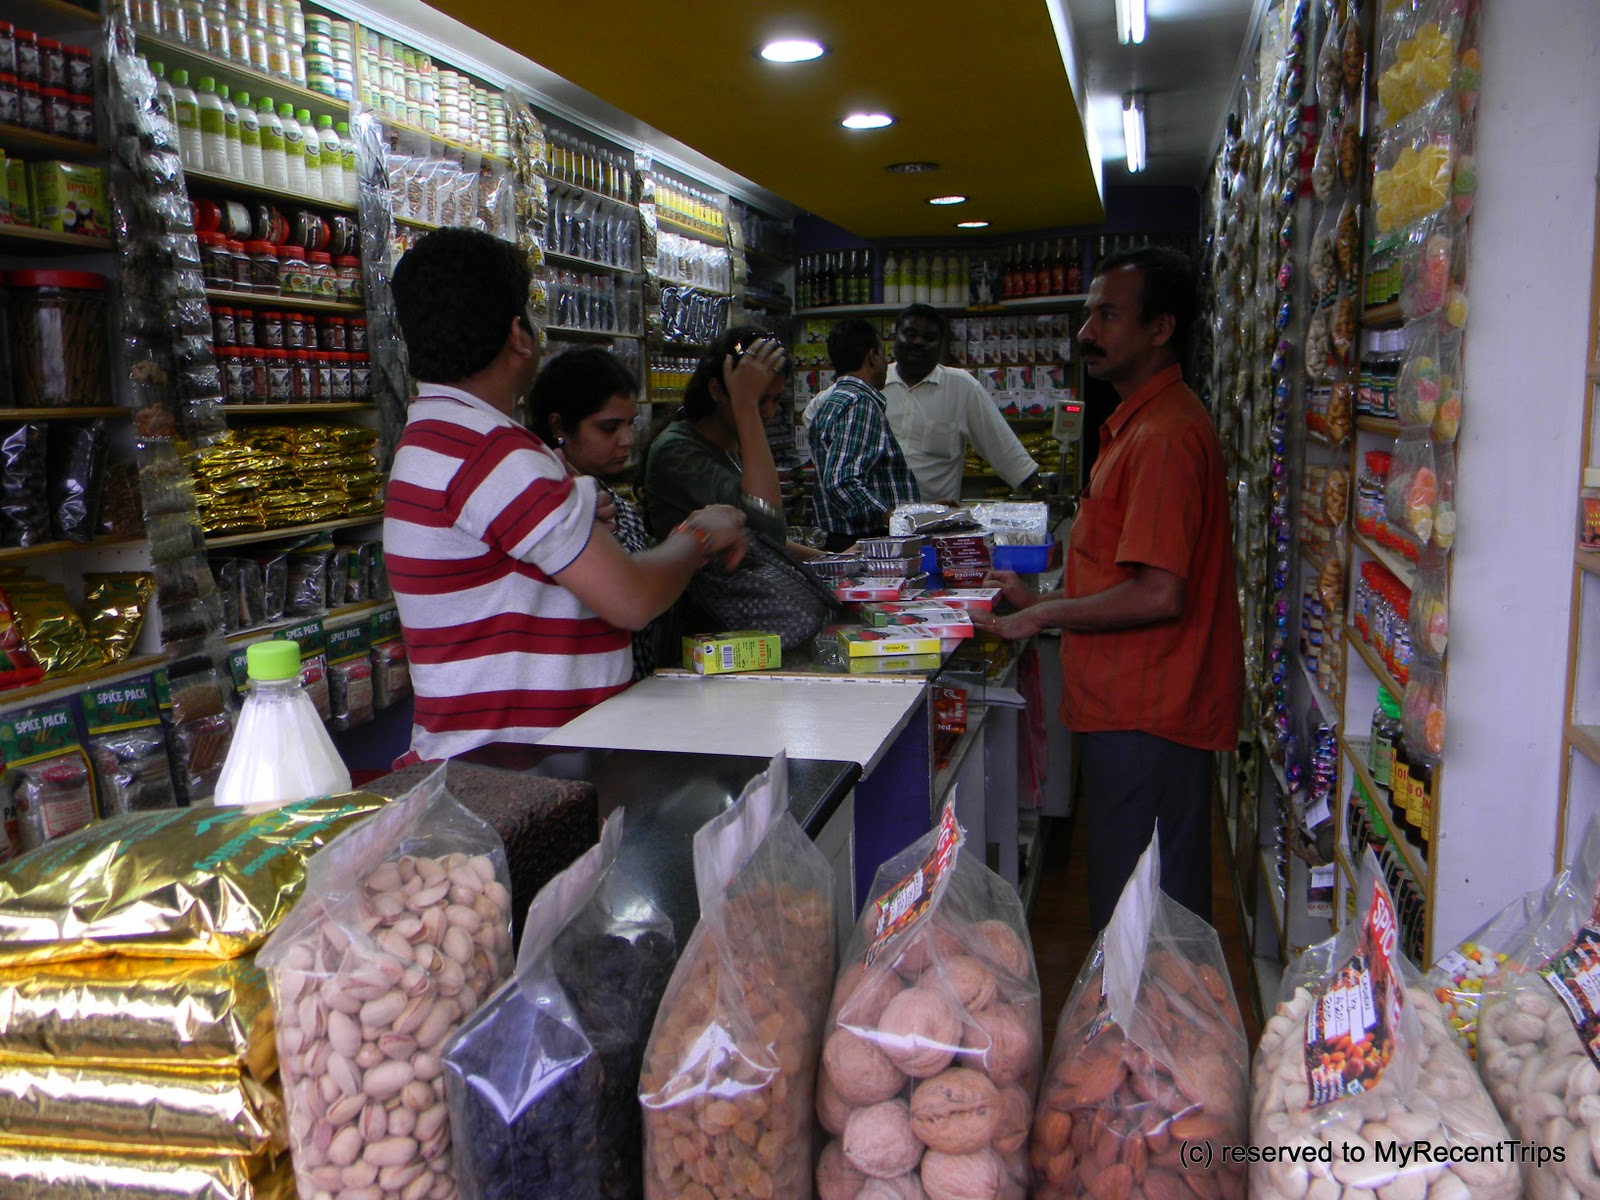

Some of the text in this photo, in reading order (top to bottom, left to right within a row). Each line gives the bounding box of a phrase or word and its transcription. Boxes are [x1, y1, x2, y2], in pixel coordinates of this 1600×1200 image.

[285, 622, 320, 641] SPICE PACK
[330, 627, 360, 643] SPICE PACK
[97, 687, 147, 705] SPICE PACK
[14, 711, 67, 735] SPICE PACK
[1372, 898, 1396, 958] SPIC
